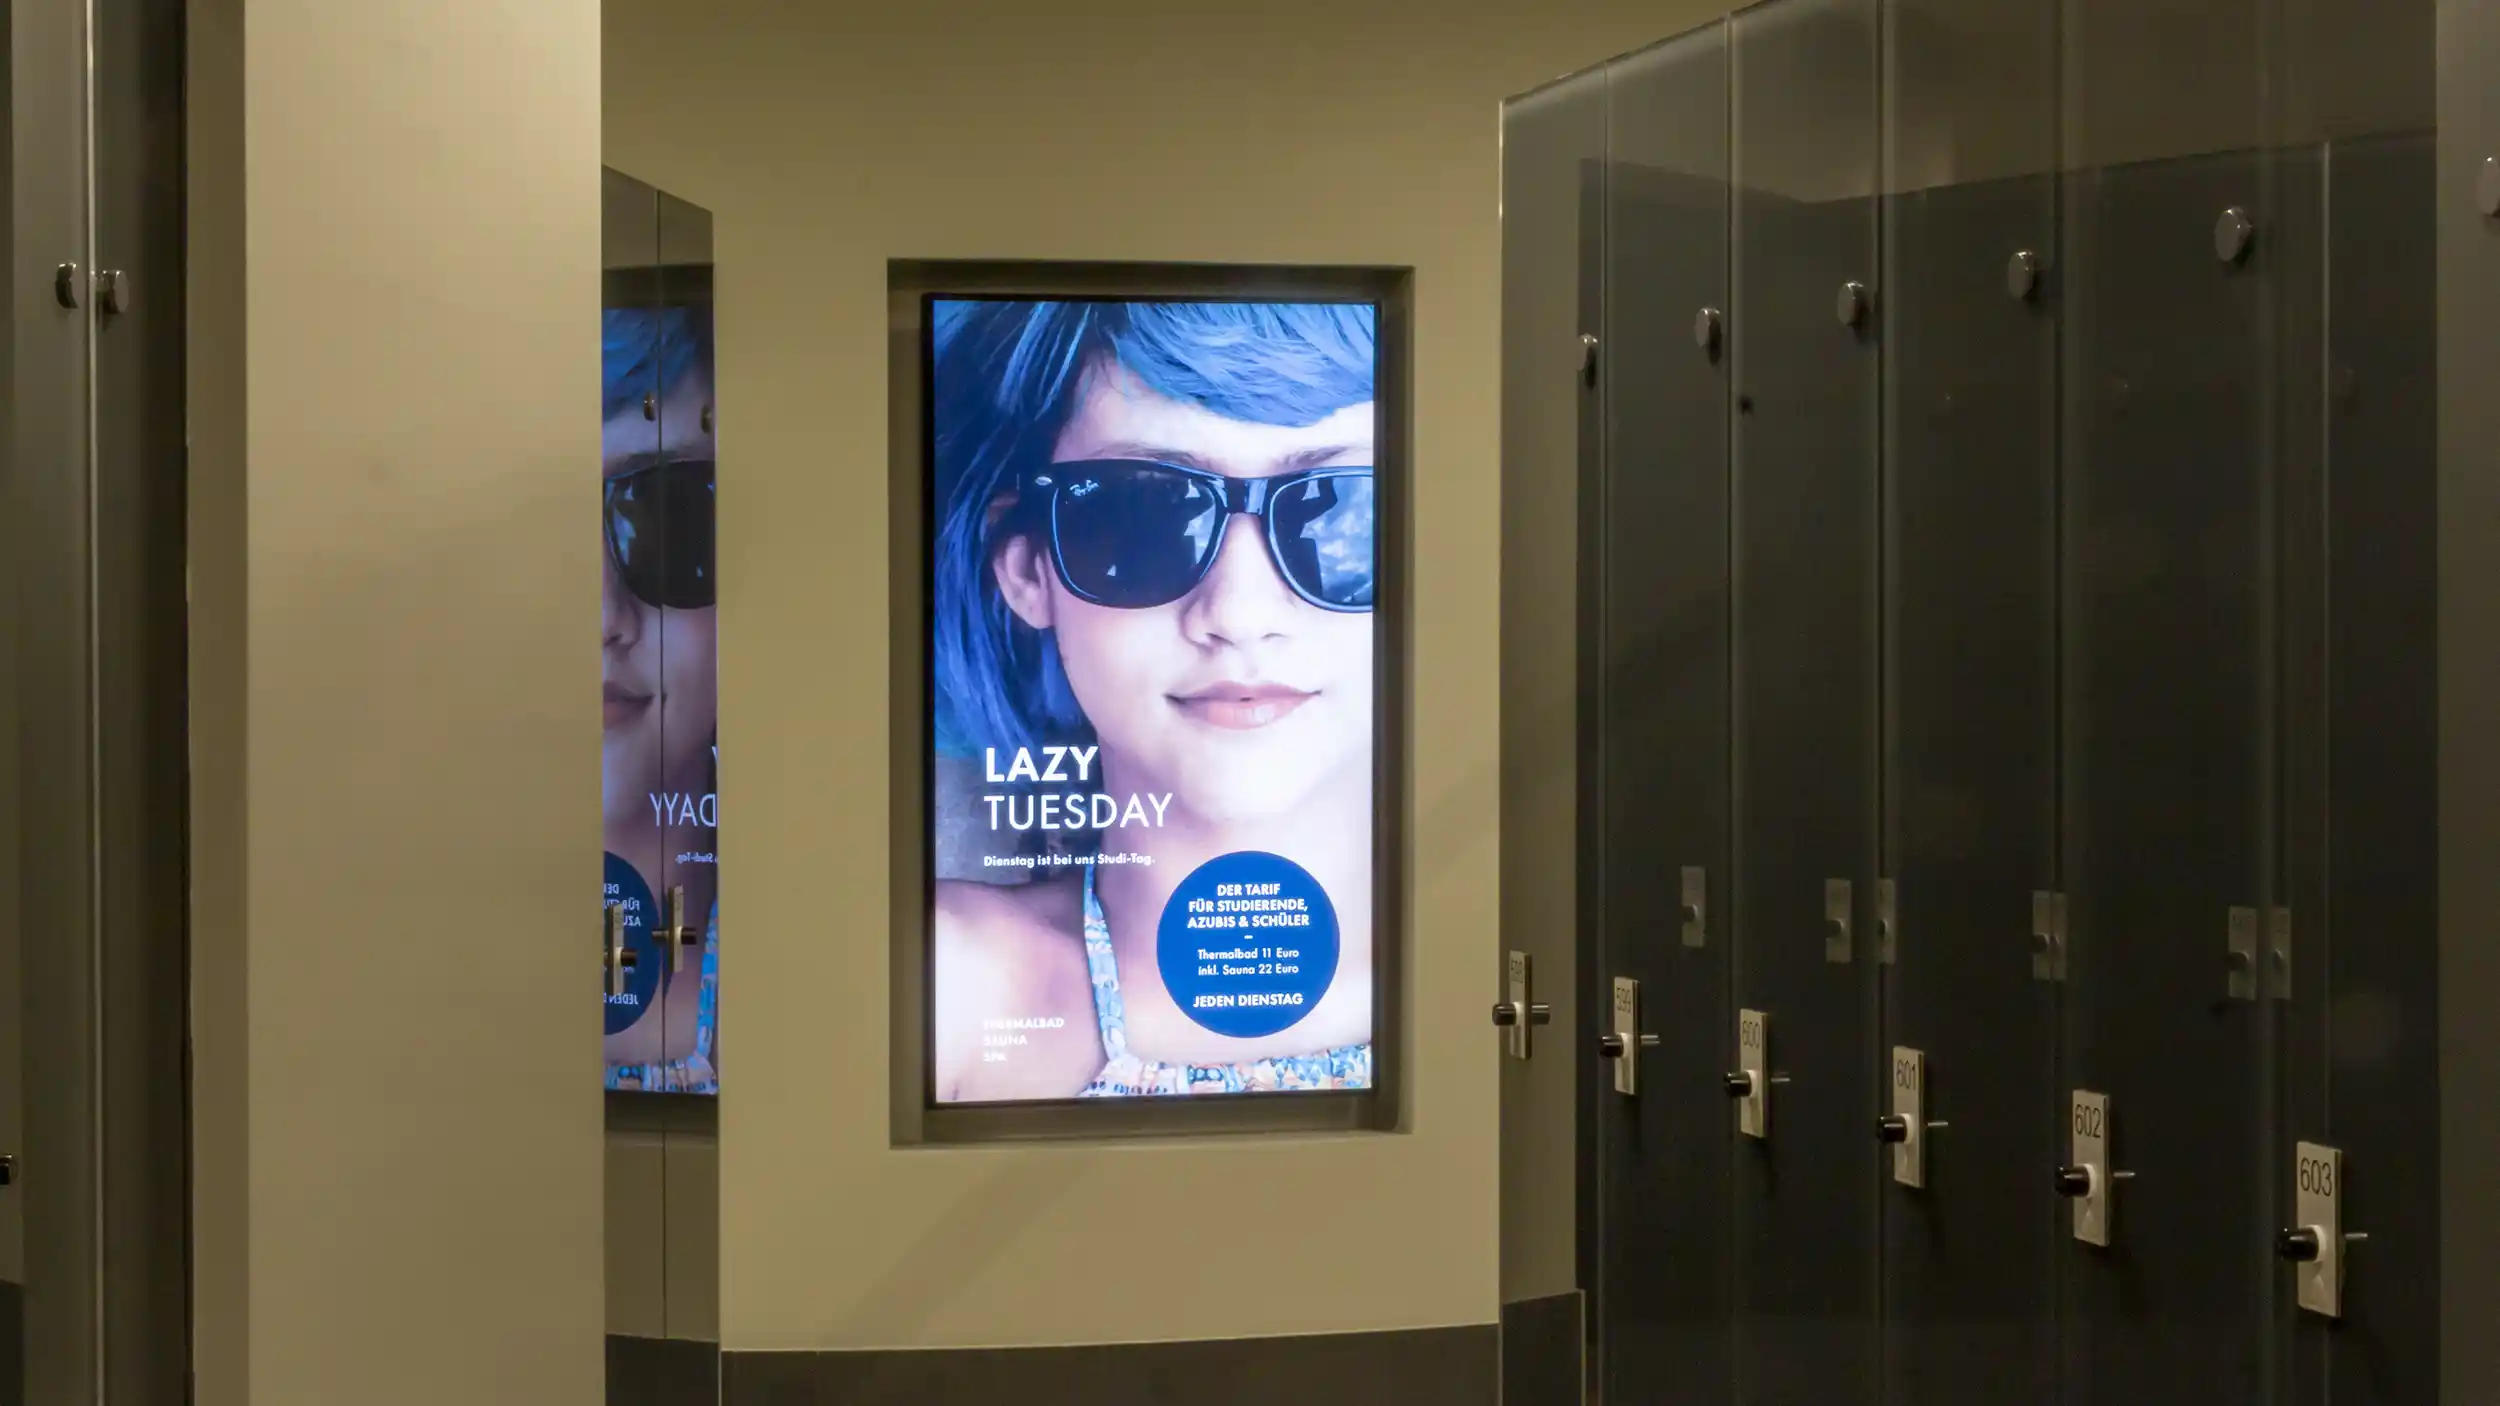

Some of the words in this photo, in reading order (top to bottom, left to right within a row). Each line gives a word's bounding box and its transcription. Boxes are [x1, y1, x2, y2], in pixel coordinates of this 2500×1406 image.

[985, 746, 1099, 783] LAZY
[983, 792, 1173, 831] TUESDAY
[983, 855, 1035, 869] Dienstag
[1037, 854, 1052, 865] ist
[1054, 853, 1072, 865] bei
[1075, 856, 1095, 865] uns
[1097, 852, 1156, 867] Studi-Tag.
[1217, 884, 1242, 896] DER
[1245, 883, 1281, 896] TARIF
[1188, 898, 1214, 912] FÜR
[1217, 899, 1308, 912] STUDIERENDE,
[1187, 916, 1236, 928] AZUBIS
[1238, 916, 1249, 927] &
[1252, 912, 1310, 927] SCHÜLER
[1197, 948, 1258, 960] Thermalbad
[1262, 948, 1272, 958] 11
[1276, 947, 1300, 958] Euro
[1198, 964, 1220, 976] inkl.
[1222, 964, 1256, 975] Sauna
[1258, 964, 1273, 974] 22
[1275, 963, 1300, 974] Euro
[1193, 995, 1235, 1008] JEDEN
[1238, 993, 1304, 1006] DIENSTAG
[1741, 1020, 1761, 1049] 600
[1896, 1059, 1918, 1091] 601
[2075, 1103, 2102, 1139] 602
[2300, 1157, 2333, 1198] 603
